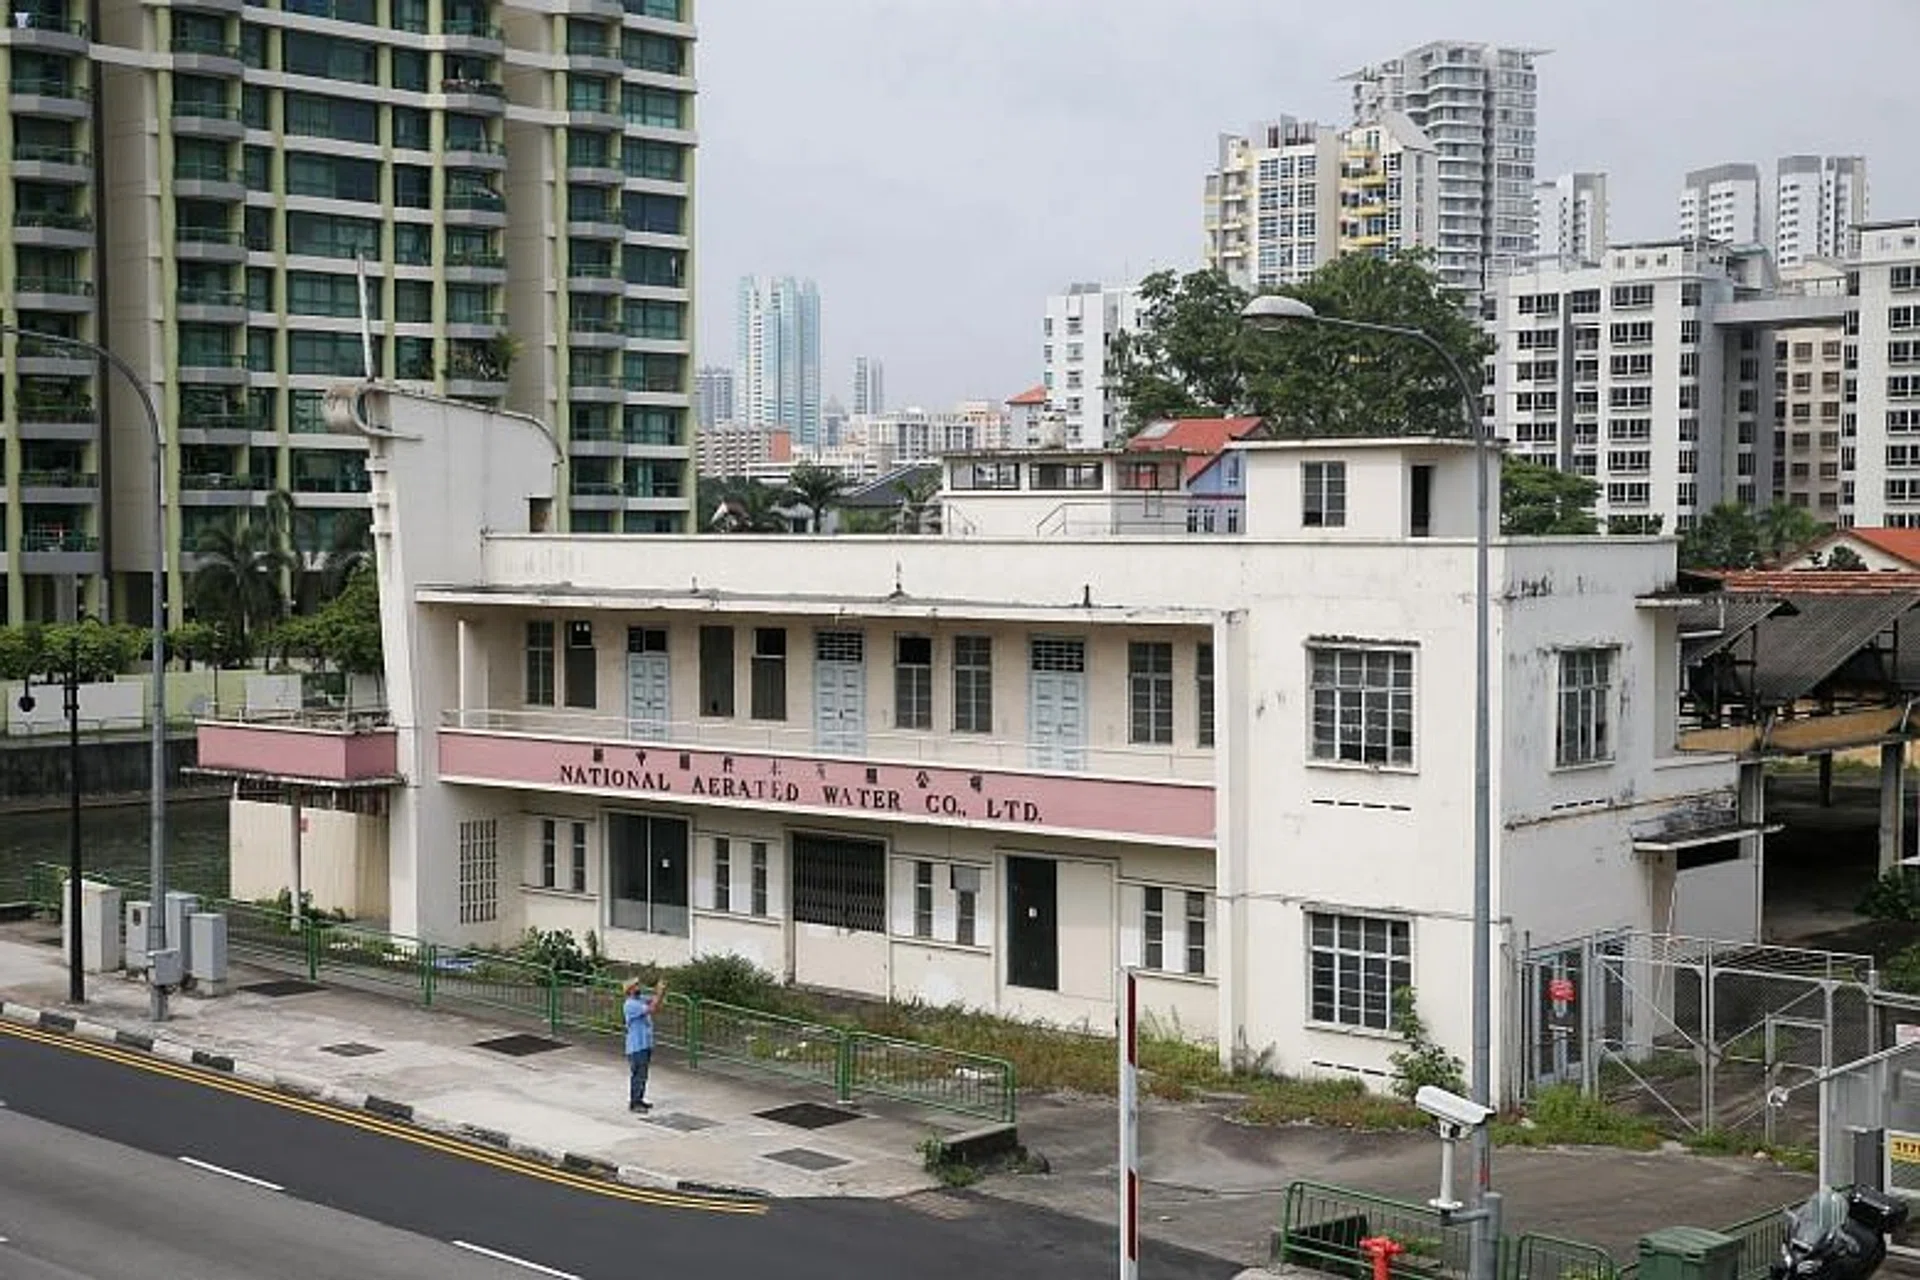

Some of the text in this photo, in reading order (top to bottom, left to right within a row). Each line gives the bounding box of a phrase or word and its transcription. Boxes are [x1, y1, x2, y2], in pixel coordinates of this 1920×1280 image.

[561, 765, 670, 792] NATIONAL
[692, 776, 799, 802] AERATED
[822, 785, 902, 811] WATER
[987, 798, 1042, 823] LTD.
